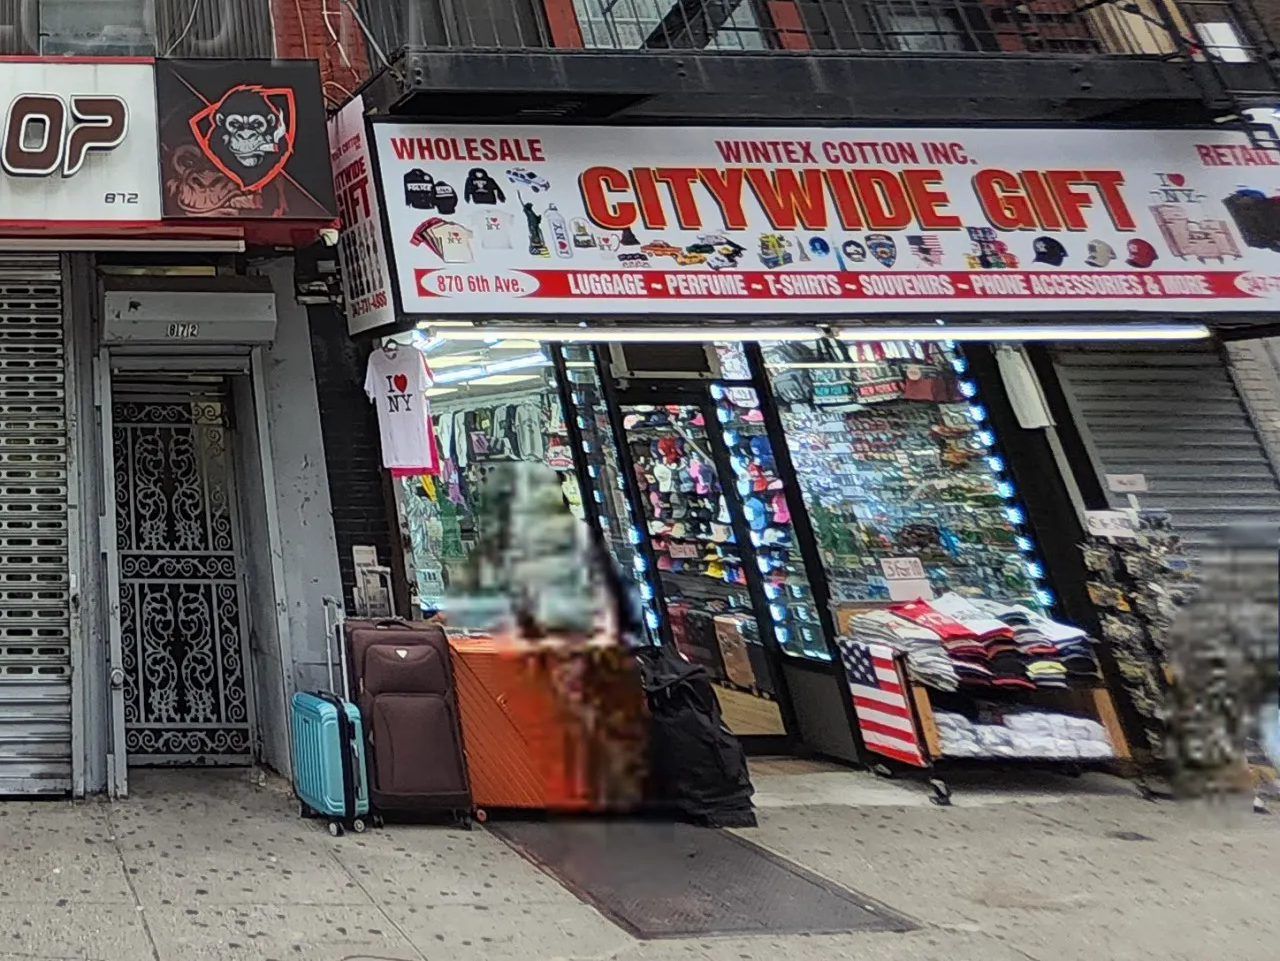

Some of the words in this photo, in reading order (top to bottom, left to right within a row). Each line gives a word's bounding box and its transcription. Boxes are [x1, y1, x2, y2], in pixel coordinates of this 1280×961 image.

[390, 137, 545, 162] WHOLESALE
[715, 140, 818, 164] WINTEX
[822, 141, 920, 165] COTTON
[922, 142, 978, 165] INC.
[105, 192, 138, 204] 872
[578, 166, 965, 231] CITYWIDE
[971, 168, 1136, 232] GIFT
[437, 275, 463, 292] 870
[468, 275, 490, 292] 6th
[495, 276, 525, 293] Ave.
[568, 273, 648, 295] LUGGAGE
[666, 273, 749, 296] PERFUME
[764, 274, 839, 297] T-SHIRTS
[859, 274, 956, 296] SOUVENIRS
[971, 274, 1031, 296] PHONE
[1032, 274, 1143, 296] ACCESSORIES
[169, 323, 197, 337] 872
[387, 375, 395, 393] I
[388, 394, 413, 413] NY
